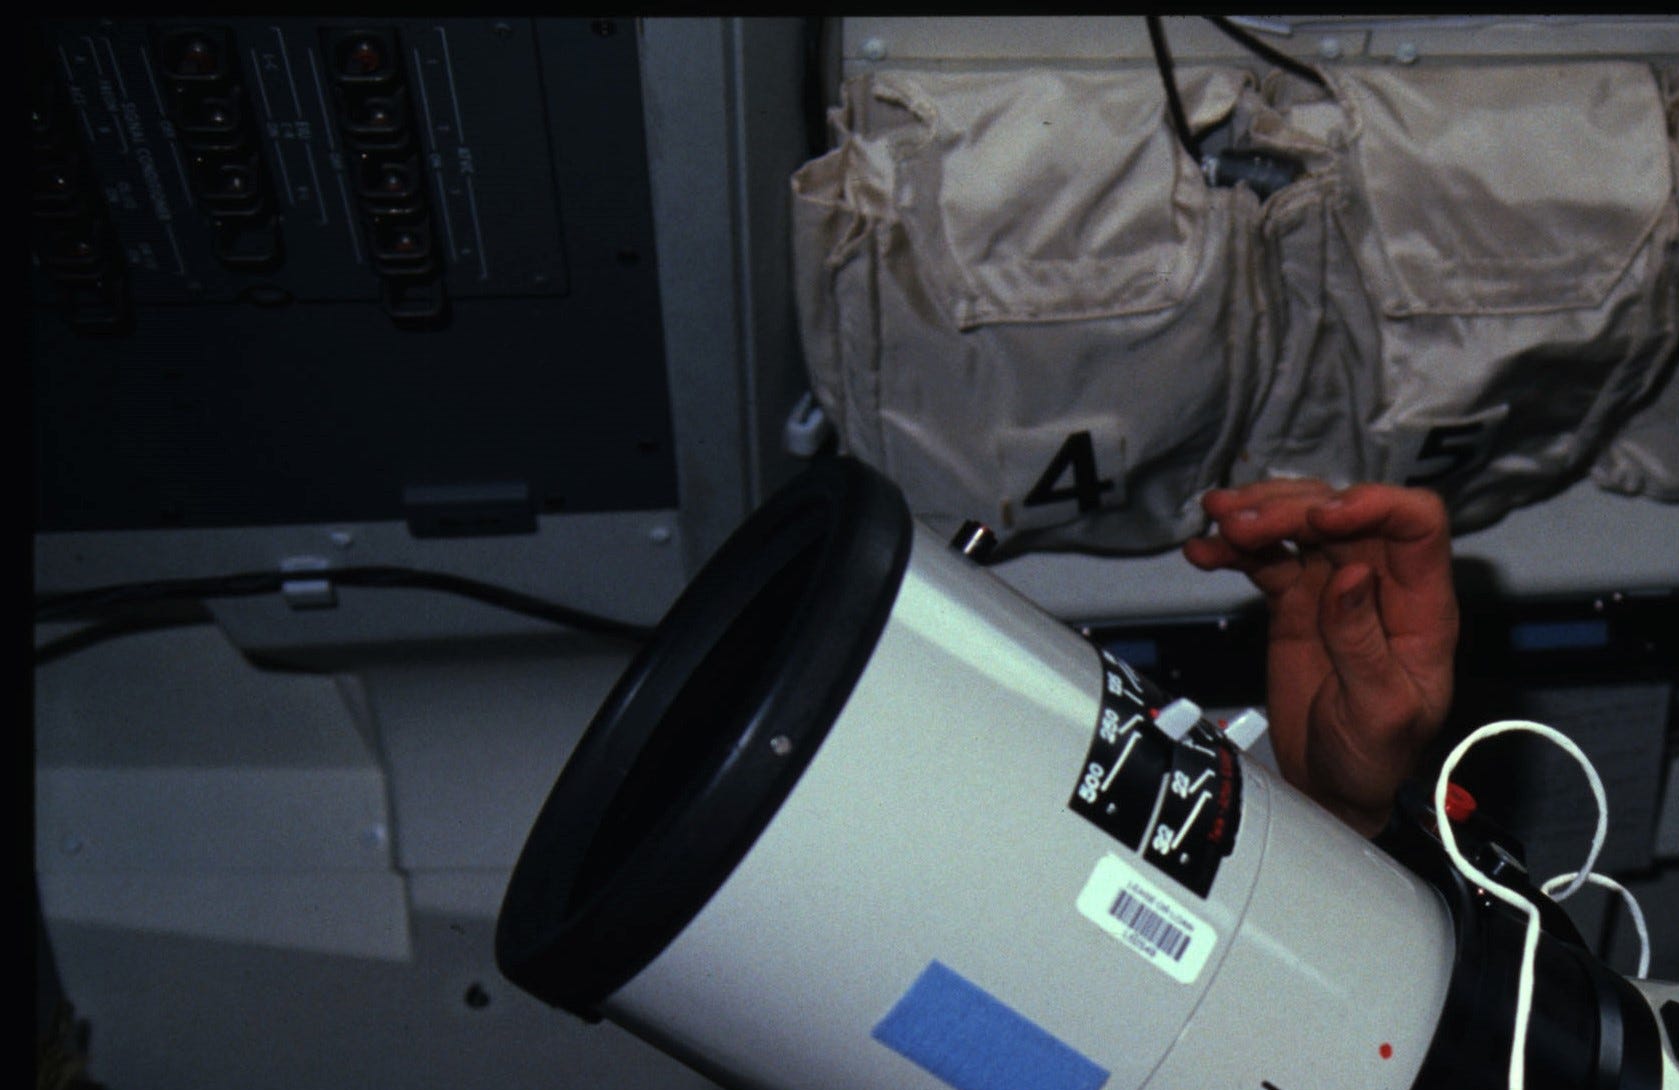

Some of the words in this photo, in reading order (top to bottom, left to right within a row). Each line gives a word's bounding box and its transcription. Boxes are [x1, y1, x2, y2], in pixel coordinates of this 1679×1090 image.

[1025, 431, 1114, 512] 4
[1406, 422, 1484, 486] 5
[1077, 761, 1105, 805] 500
